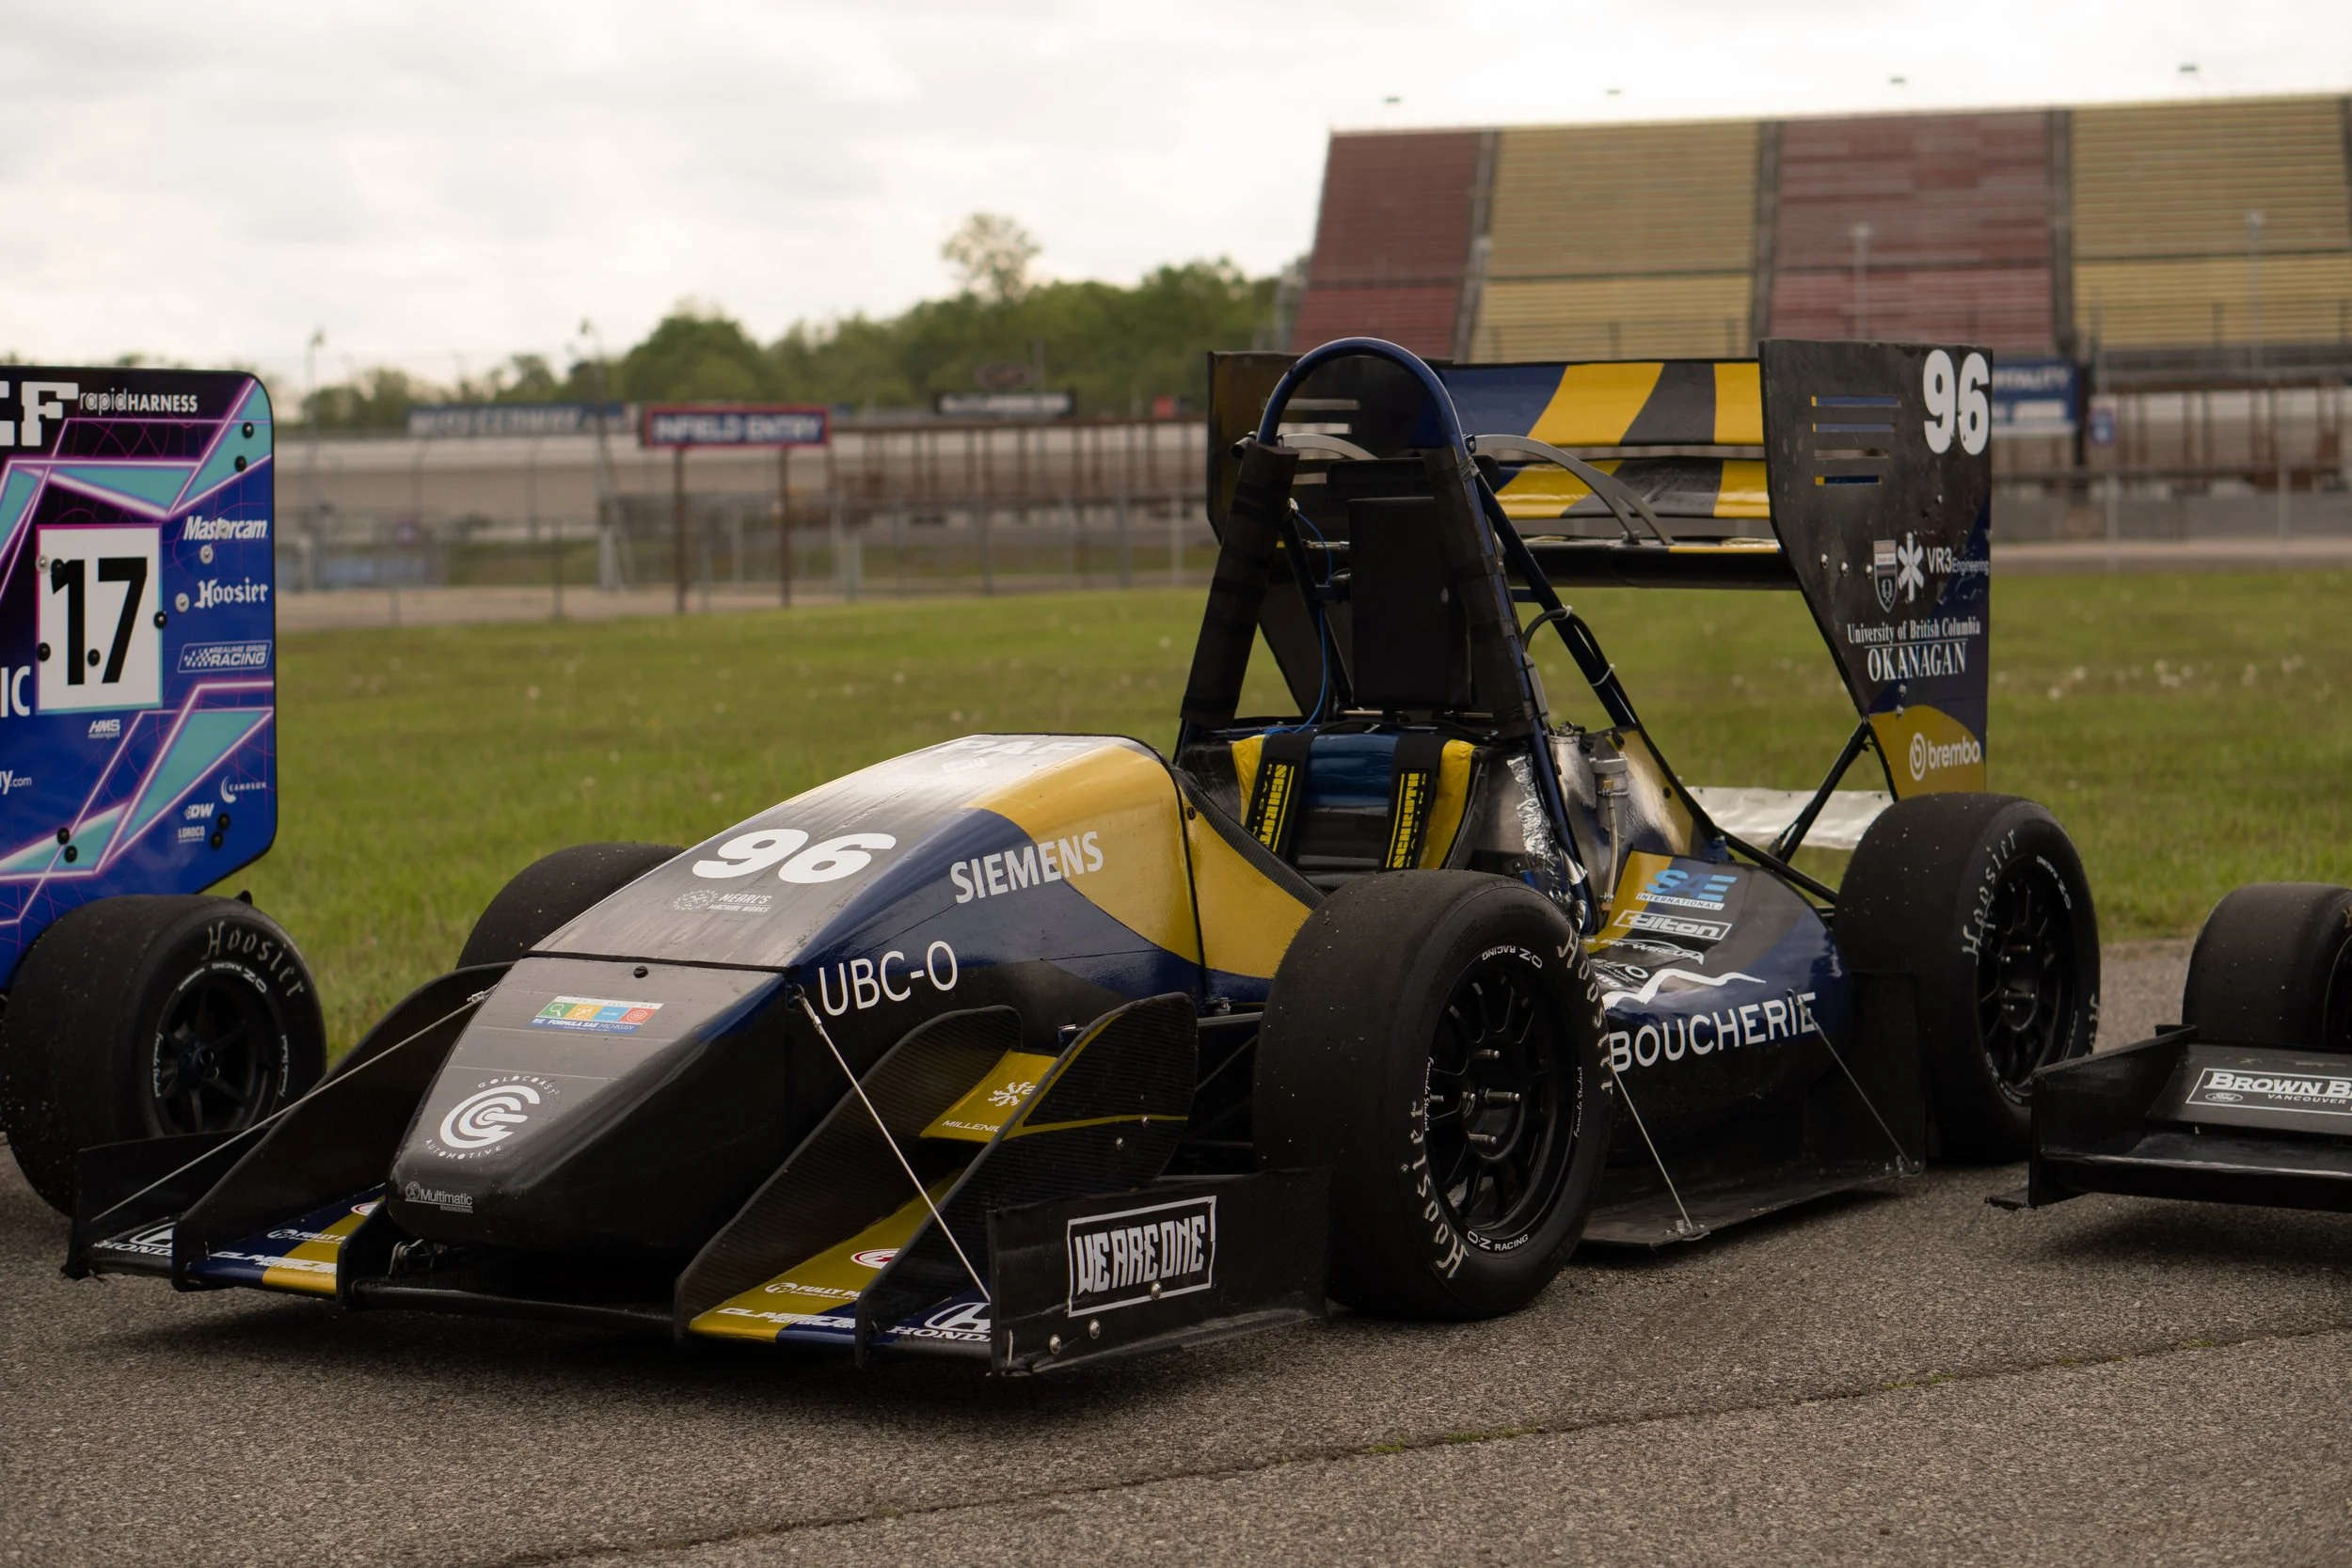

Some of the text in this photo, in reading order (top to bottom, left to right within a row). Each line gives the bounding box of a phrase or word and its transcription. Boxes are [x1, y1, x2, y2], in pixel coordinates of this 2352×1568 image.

[1923, 349, 1990, 455] 96
[183, 515, 268, 541] Mastrcam
[1927, 546, 1953, 574] VR3
[194, 578, 269, 609] Hoosier
[50, 557, 148, 686] 17
[1847, 615, 1981, 645] University of British Columbia
[210, 651, 266, 667] RACING
[1867, 641, 1967, 682] OKANAGAN
[88, 719, 120, 733] HMS
[1929, 736, 1980, 769] brembo
[692, 829, 897, 883] 96
[950, 831, 1104, 905] SIEMENS
[1646, 869, 1738, 902] SAE
[200, 921, 305, 997] Hoosier
[1481, 945, 1517, 960] RACING
[818, 941, 959, 1016] UBC-O
[1610, 992, 1819, 1072] BOUCHERIE
[2203, 1071, 2323, 1096] BROWN
[2267, 1093, 2348, 1104] VANCOUVER
[425, 1139, 501, 1160] AUTOMOTIVE
[421, 1188, 473, 1206] Multimatic
[1494, 1233, 1529, 1252] RACING
[796, 1285, 845, 1295] FULLY
